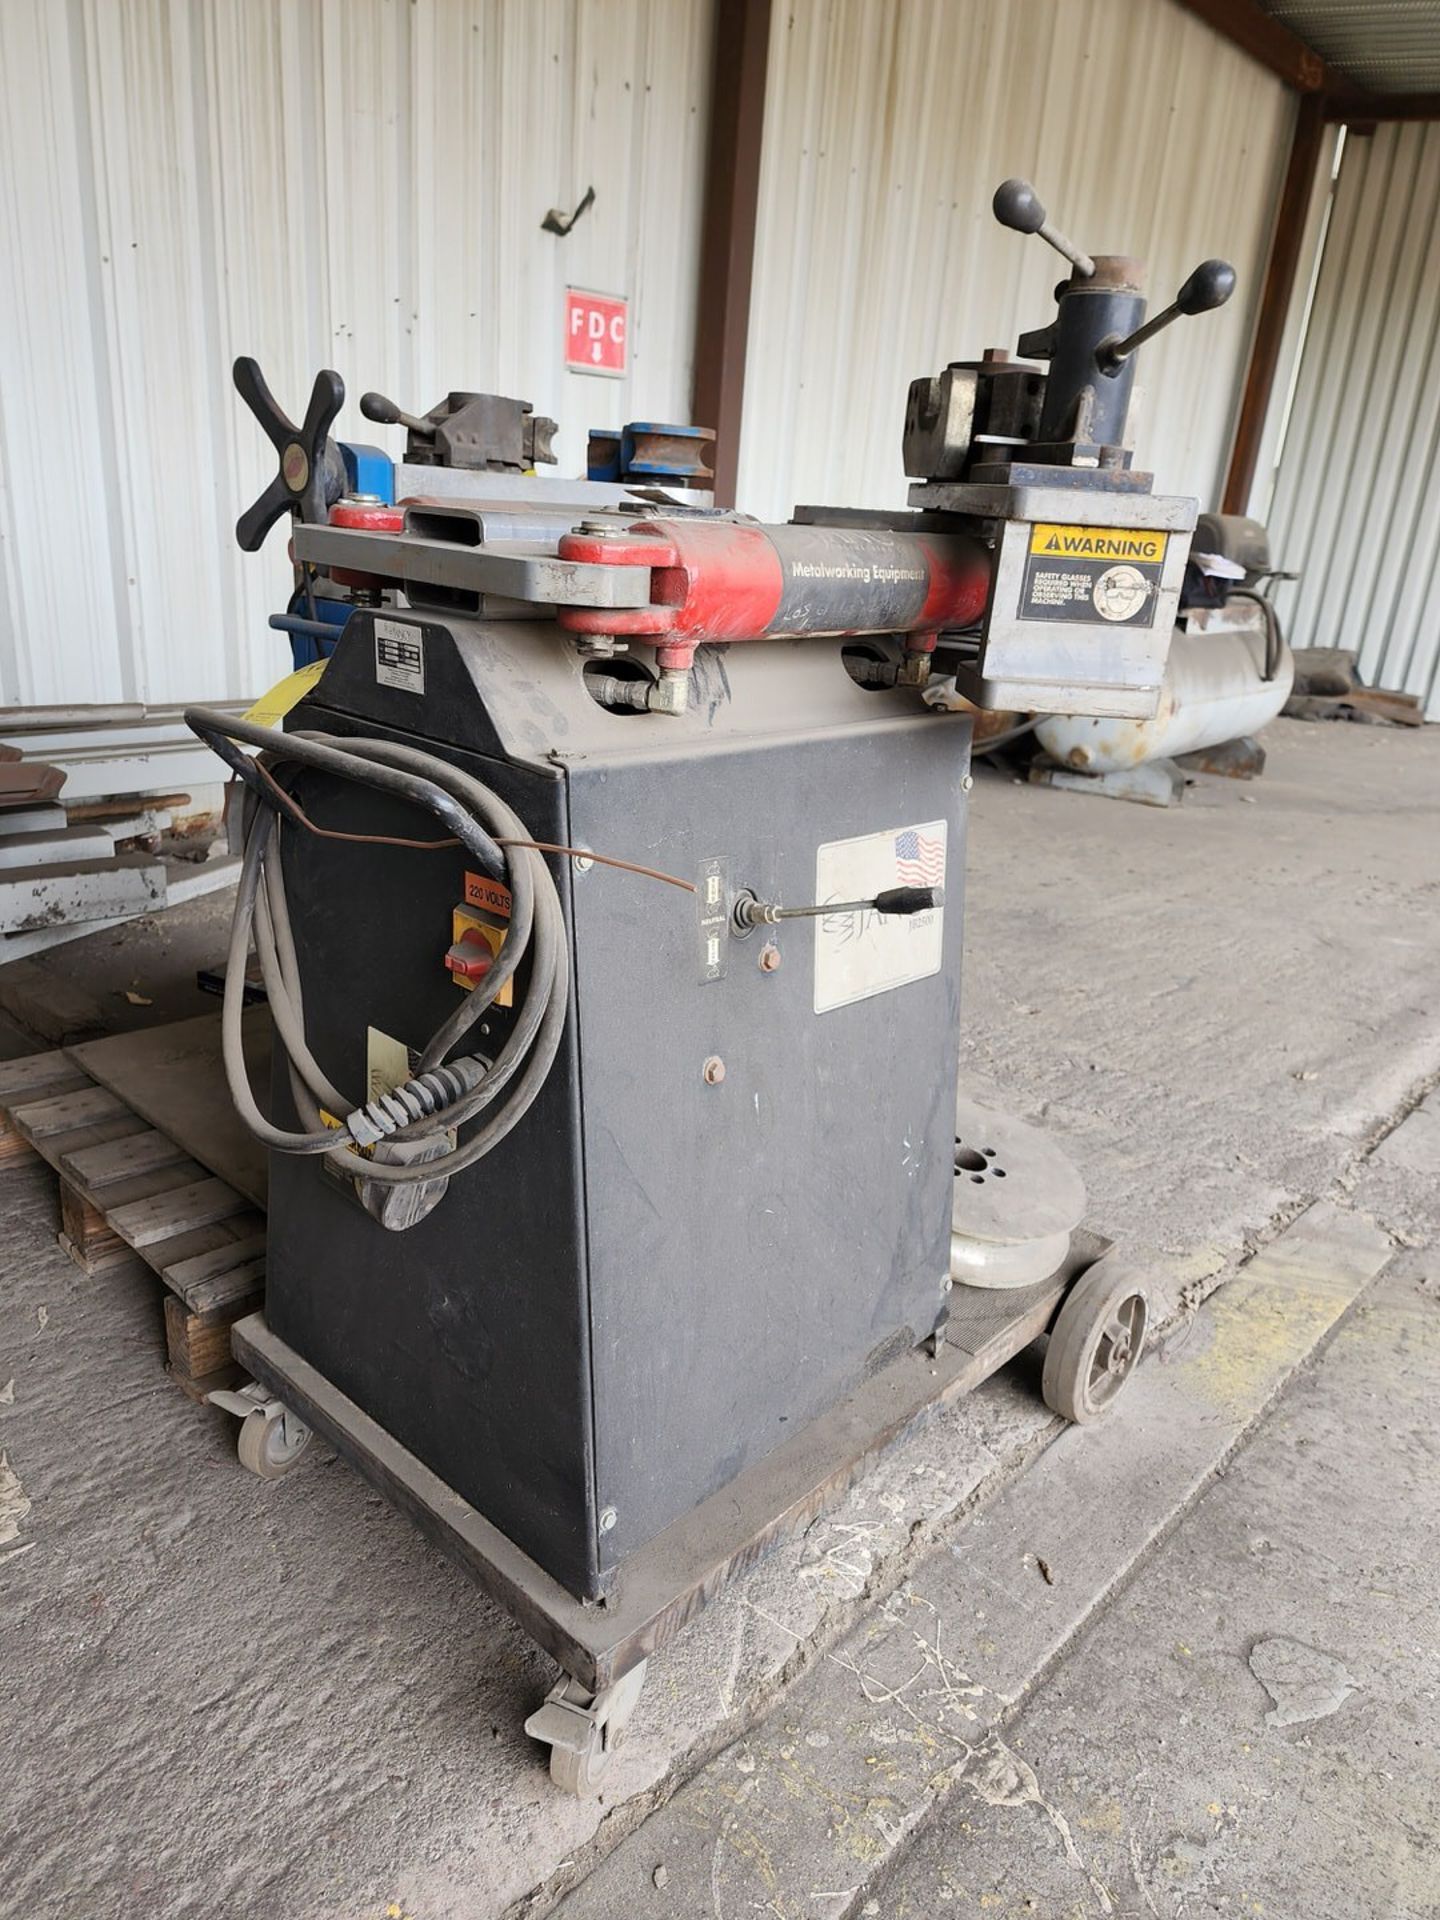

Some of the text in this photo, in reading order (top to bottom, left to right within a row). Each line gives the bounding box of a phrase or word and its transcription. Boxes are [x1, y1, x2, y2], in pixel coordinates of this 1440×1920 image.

[571, 307, 625, 343] FDC
[1063, 536, 1157, 557] WARNING
[792, 561, 925, 583] Metalworking Equipment
[1036, 572, 1091, 581] SAFETY GLASSES
[1033, 585, 1073, 593] OPERATING
[1034, 578, 1092, 589] REQUIRED WHEN
[1032, 591, 1072, 600] OBSERVING
[469, 884, 511, 910] 220 VOLTS
